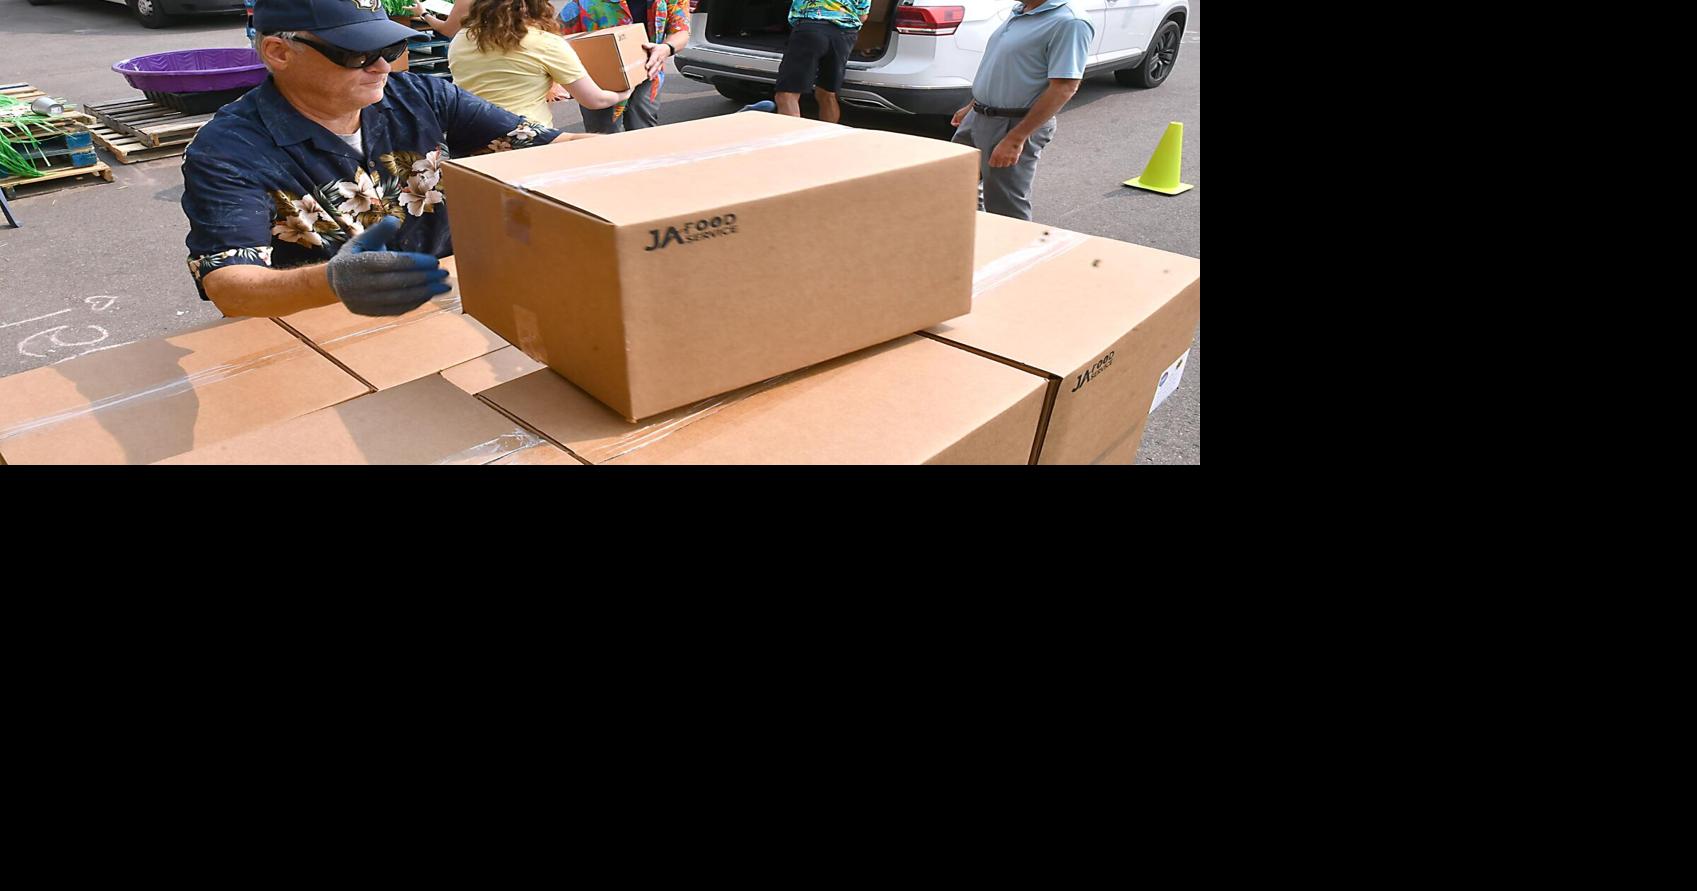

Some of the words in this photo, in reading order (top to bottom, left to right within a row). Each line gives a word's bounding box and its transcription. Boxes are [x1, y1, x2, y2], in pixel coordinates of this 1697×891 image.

[644, 227, 685, 251] JA
[684, 213, 737, 234] FOOD
[1071, 369, 1090, 393] JA
